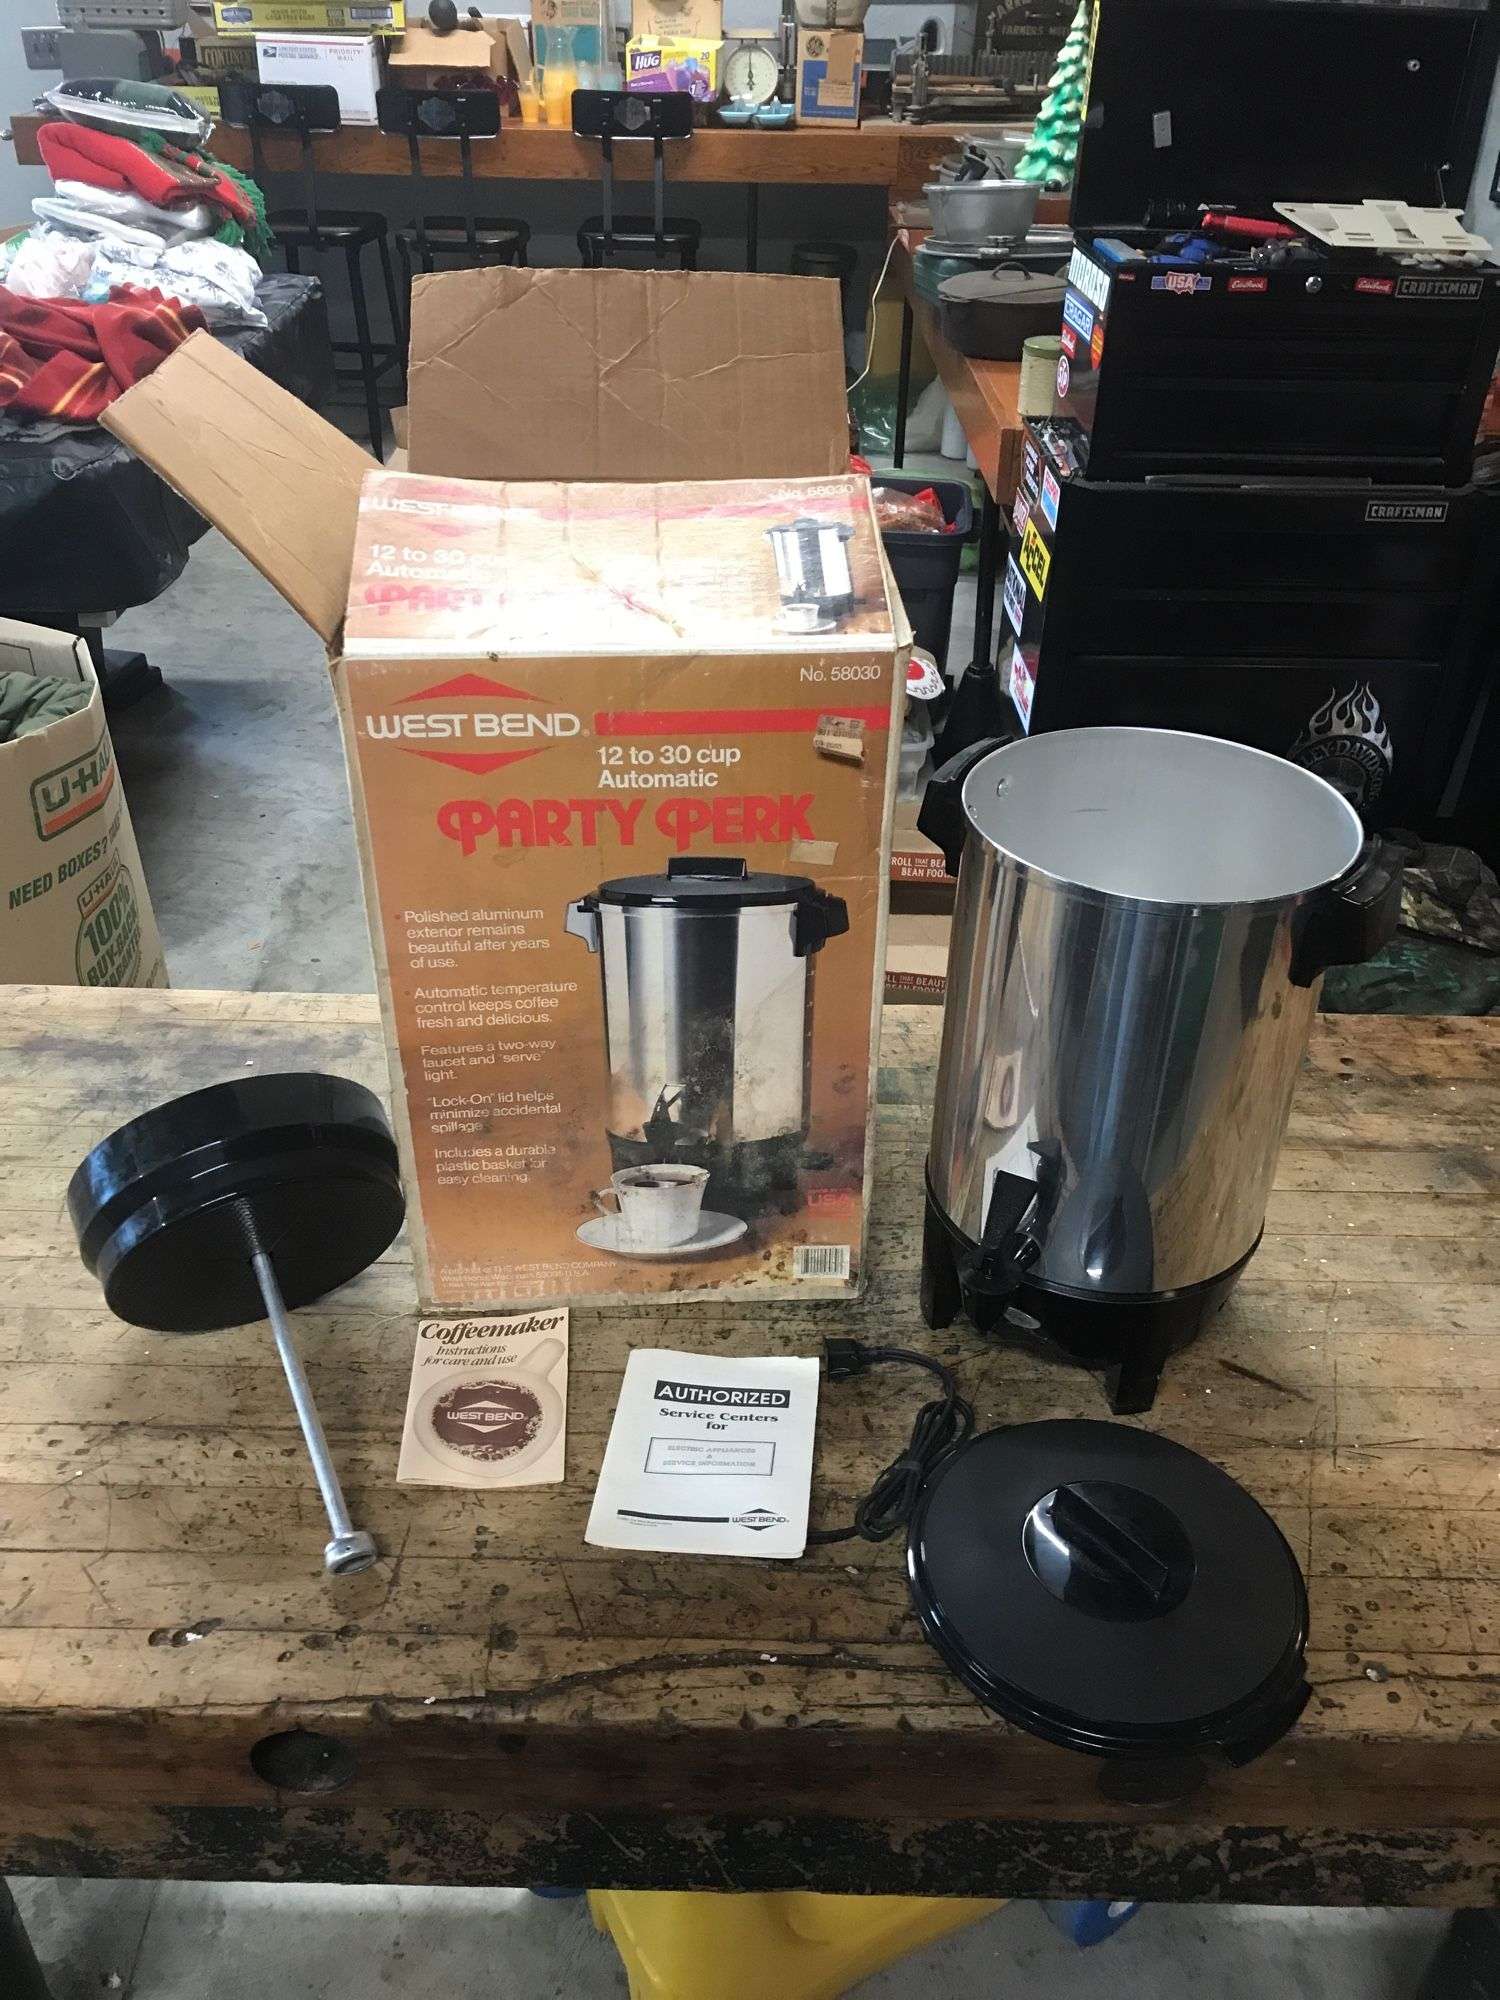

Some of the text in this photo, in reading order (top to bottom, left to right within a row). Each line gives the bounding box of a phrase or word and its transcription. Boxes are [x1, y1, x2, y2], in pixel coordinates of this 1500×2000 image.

[1167, 273, 1195, 291] USA
[1400, 279, 1478, 296] CRAFTSMAN
[1371, 504, 1443, 519] CRAFTSMAN
[370, 543, 396, 560] 12
[402, 545, 428, 562] to
[800, 665, 880, 682] No. 58030
[366, 713, 581, 739] WEST BEND
[599, 745, 741, 766] 12 to 30 cup
[598, 769, 719, 788] Automatic
[437, 794, 816, 856] PARTY PERK
[891, 857, 912, 867] ROLL
[9, 840, 109, 911] NEED BOXES?
[901, 867, 924, 877] BEAN
[404, 908, 544, 923] Polished aluminum
[407, 923, 526, 939] exterior remains
[408, 938, 551, 954] beautiful after years
[410, 956, 459, 968] of use.
[414, 981, 578, 999] Automatic temperature
[415, 996, 560, 1014] control keeps coffee
[416, 1011, 553, 1029] fresh and delicious.
[421, 1039, 557, 1056] Features a two-way
[422, 1056, 466, 1068] faucet
[469, 1053, 495, 1065] and
[424, 1070, 458, 1083] light.
[517, 1091, 555, 1103] helps
[430, 1103, 561, 1120] minimize accidental
[434, 1144, 556, 1159] Includes a durable
[436, 1158, 480, 1172] plastic
[482, 1157, 527, 1171] basket
[437, 1173, 473, 1186] easy
[420, 1315, 565, 1345] Coffeemaker
[436, 1344, 507, 1356] Instructions
[421, 1354, 517, 1366] for care and use
[657, 1384, 786, 1406] AUTHORIZED
[447, 1411, 525, 1422] WEST BEND
[659, 1407, 779, 1423] Service Centers
[706, 1421, 728, 1431] for
[667, 1444, 757, 1454] ELECTRIC APPLIANCES
[731, 1516, 787, 1524] WEST BEND
